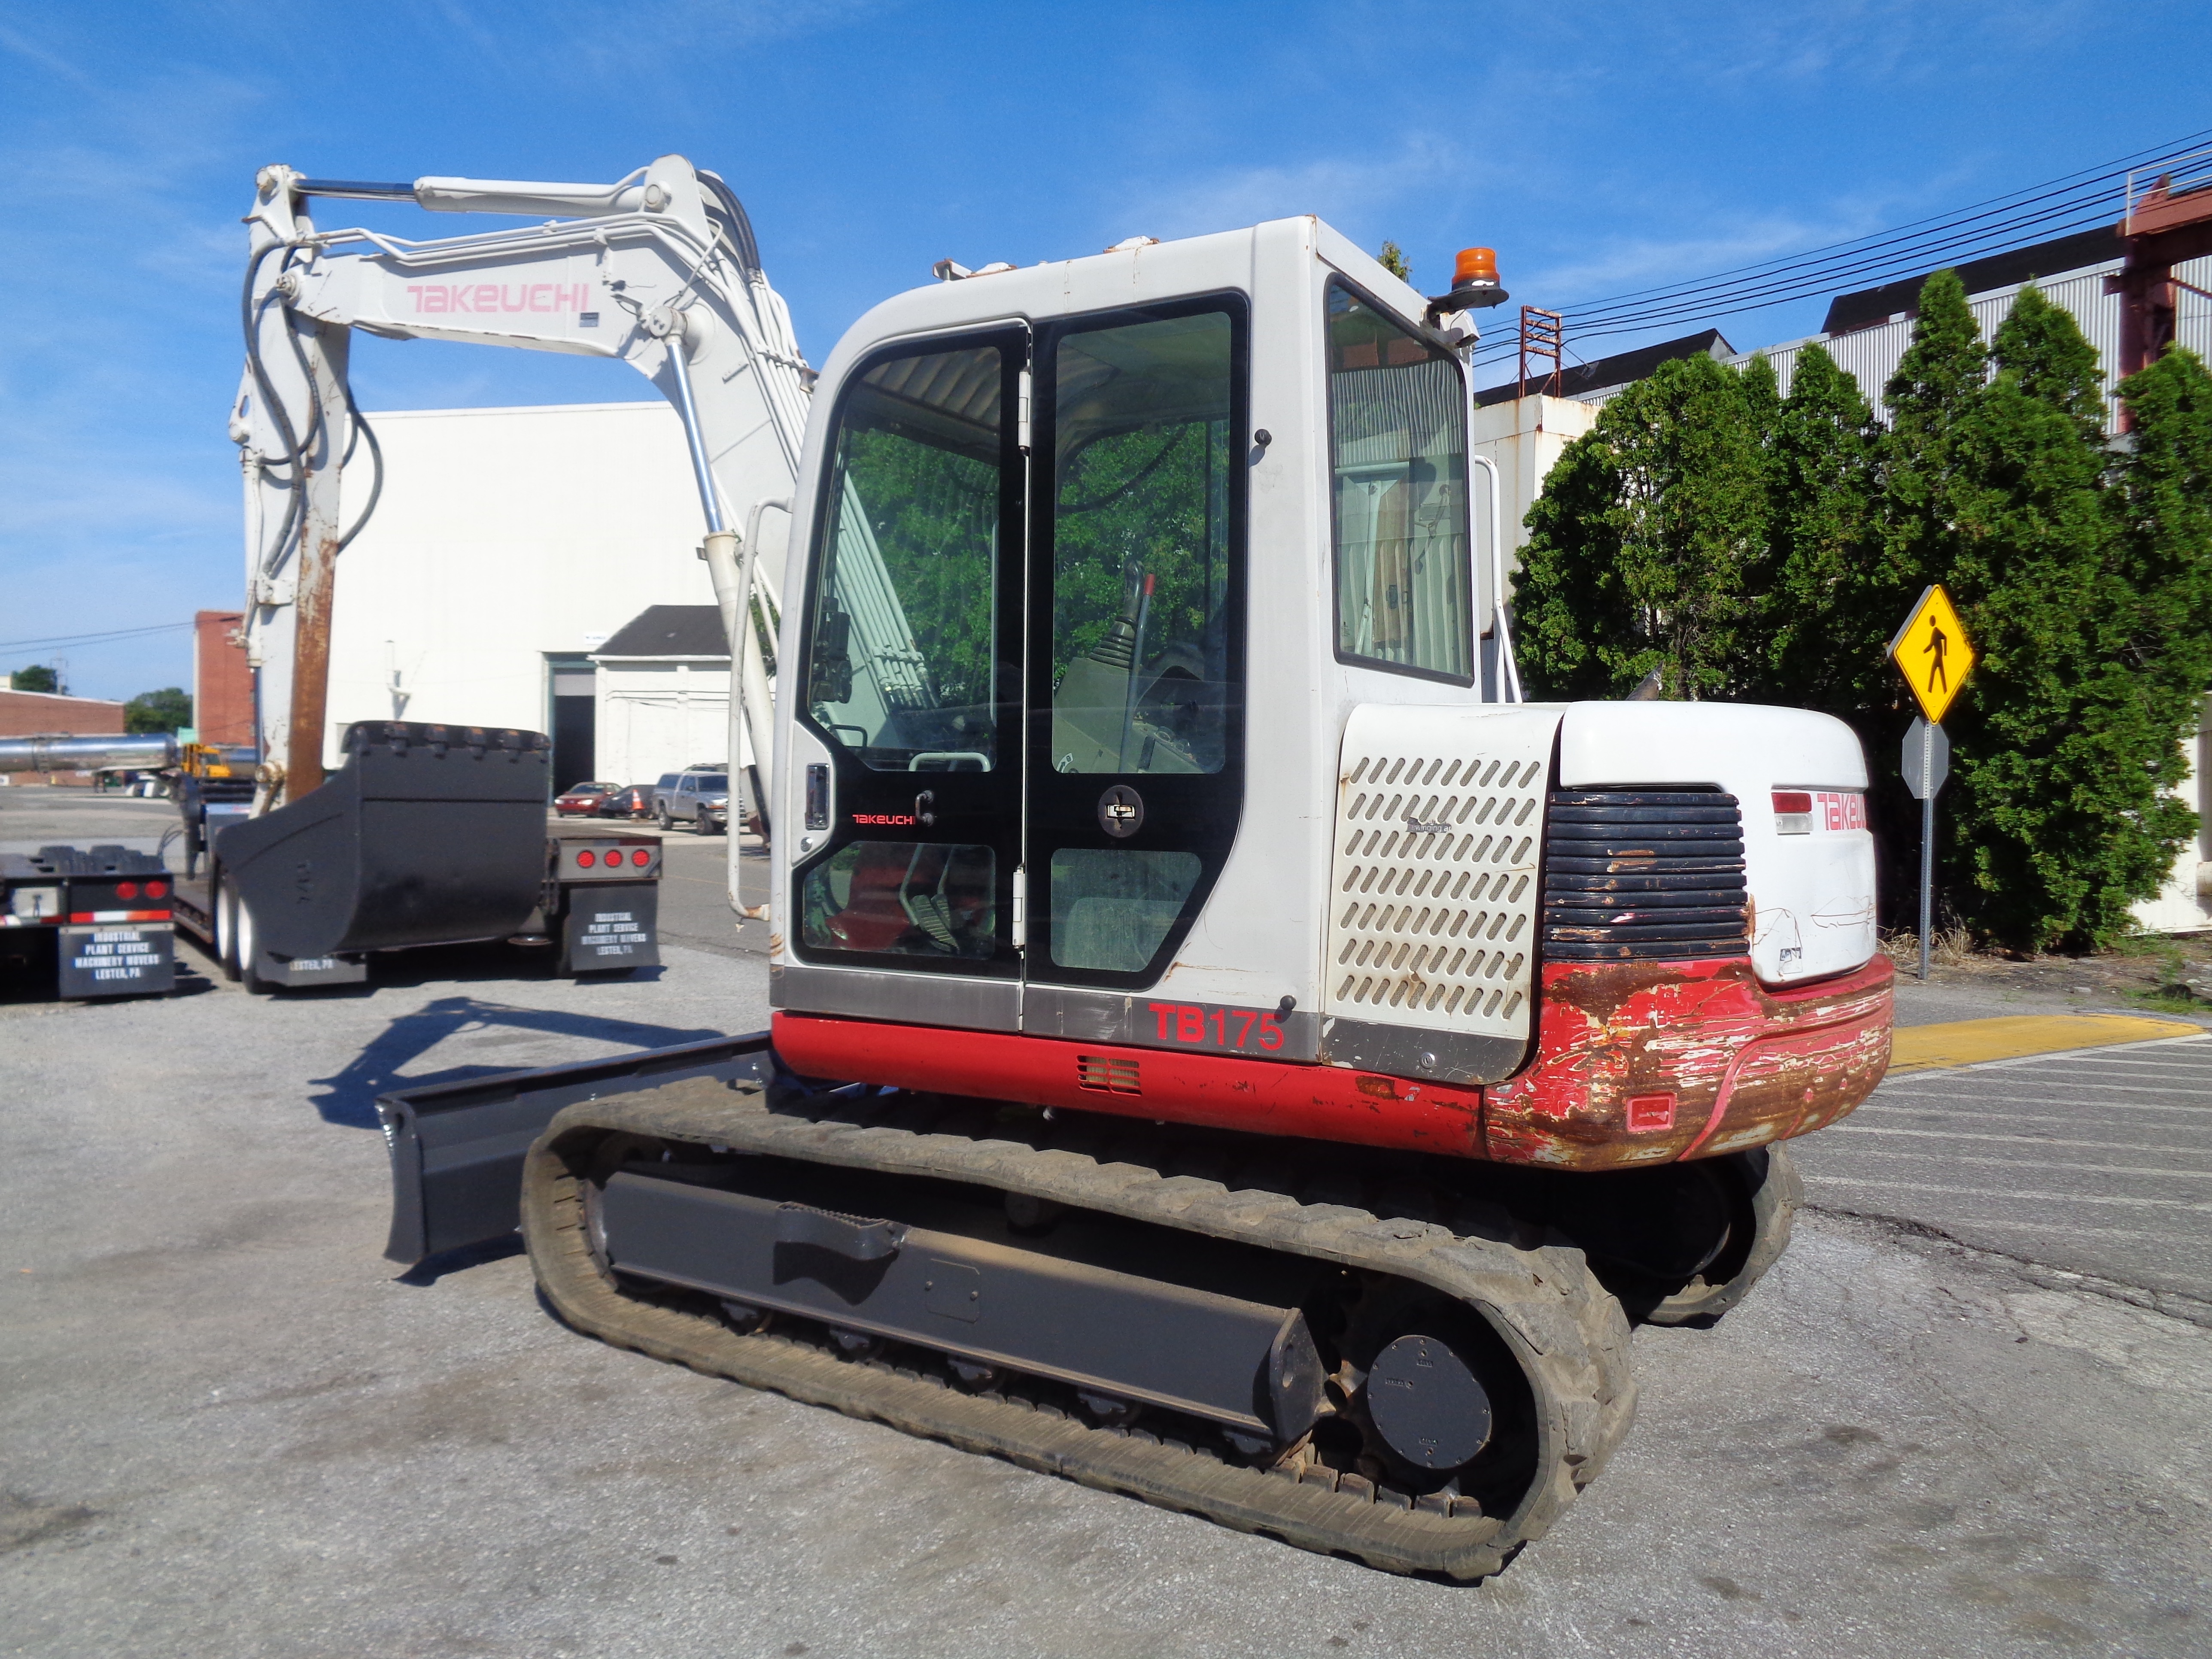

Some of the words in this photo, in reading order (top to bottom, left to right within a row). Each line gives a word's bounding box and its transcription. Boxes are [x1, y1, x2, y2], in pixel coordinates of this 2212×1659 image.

[85, 943, 113, 956] PLANT
[117, 942, 150, 954] SERVICE
[75, 955, 123, 969] MACHINERY
[126, 954, 160, 966] MOVERS
[129, 966, 141, 978] PA
[1149, 1003, 1284, 1051] TB175
